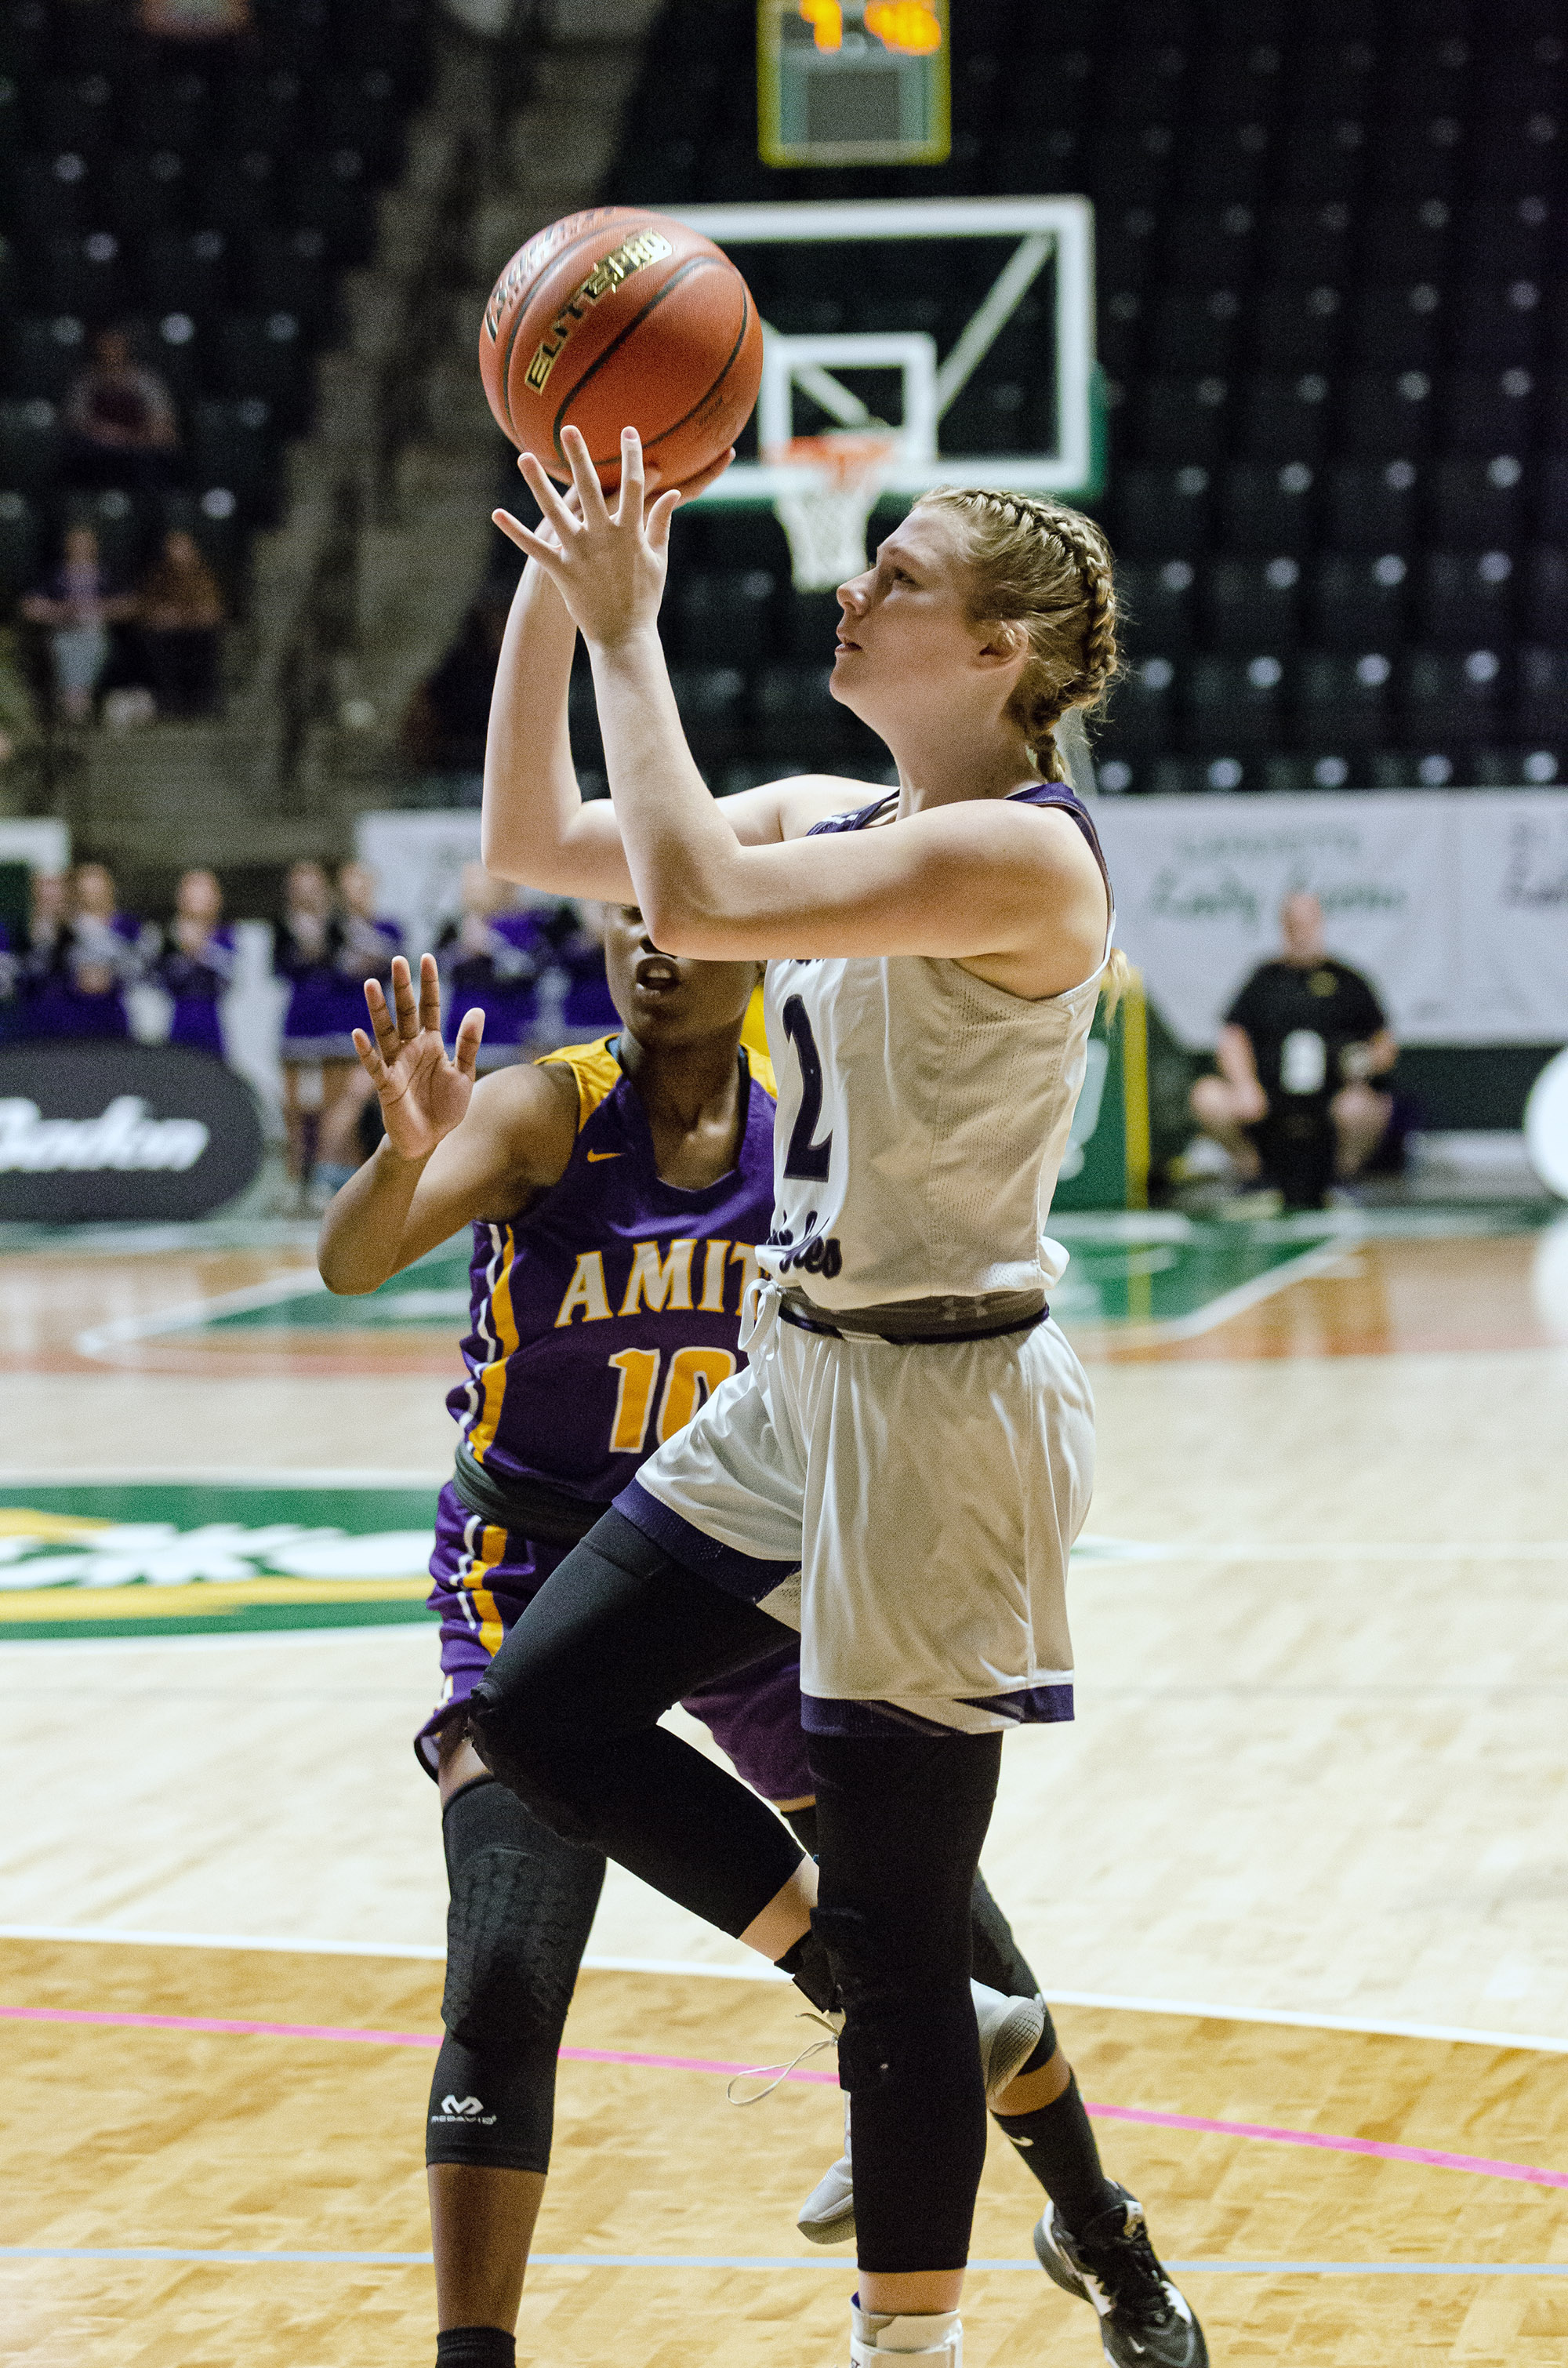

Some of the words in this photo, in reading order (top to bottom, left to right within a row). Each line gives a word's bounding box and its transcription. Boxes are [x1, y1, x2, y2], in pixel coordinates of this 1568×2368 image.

[782, 993, 833, 1182] 2
[554, 1238, 772, 1328] AMIT
[608, 1346, 736, 1455] 10
